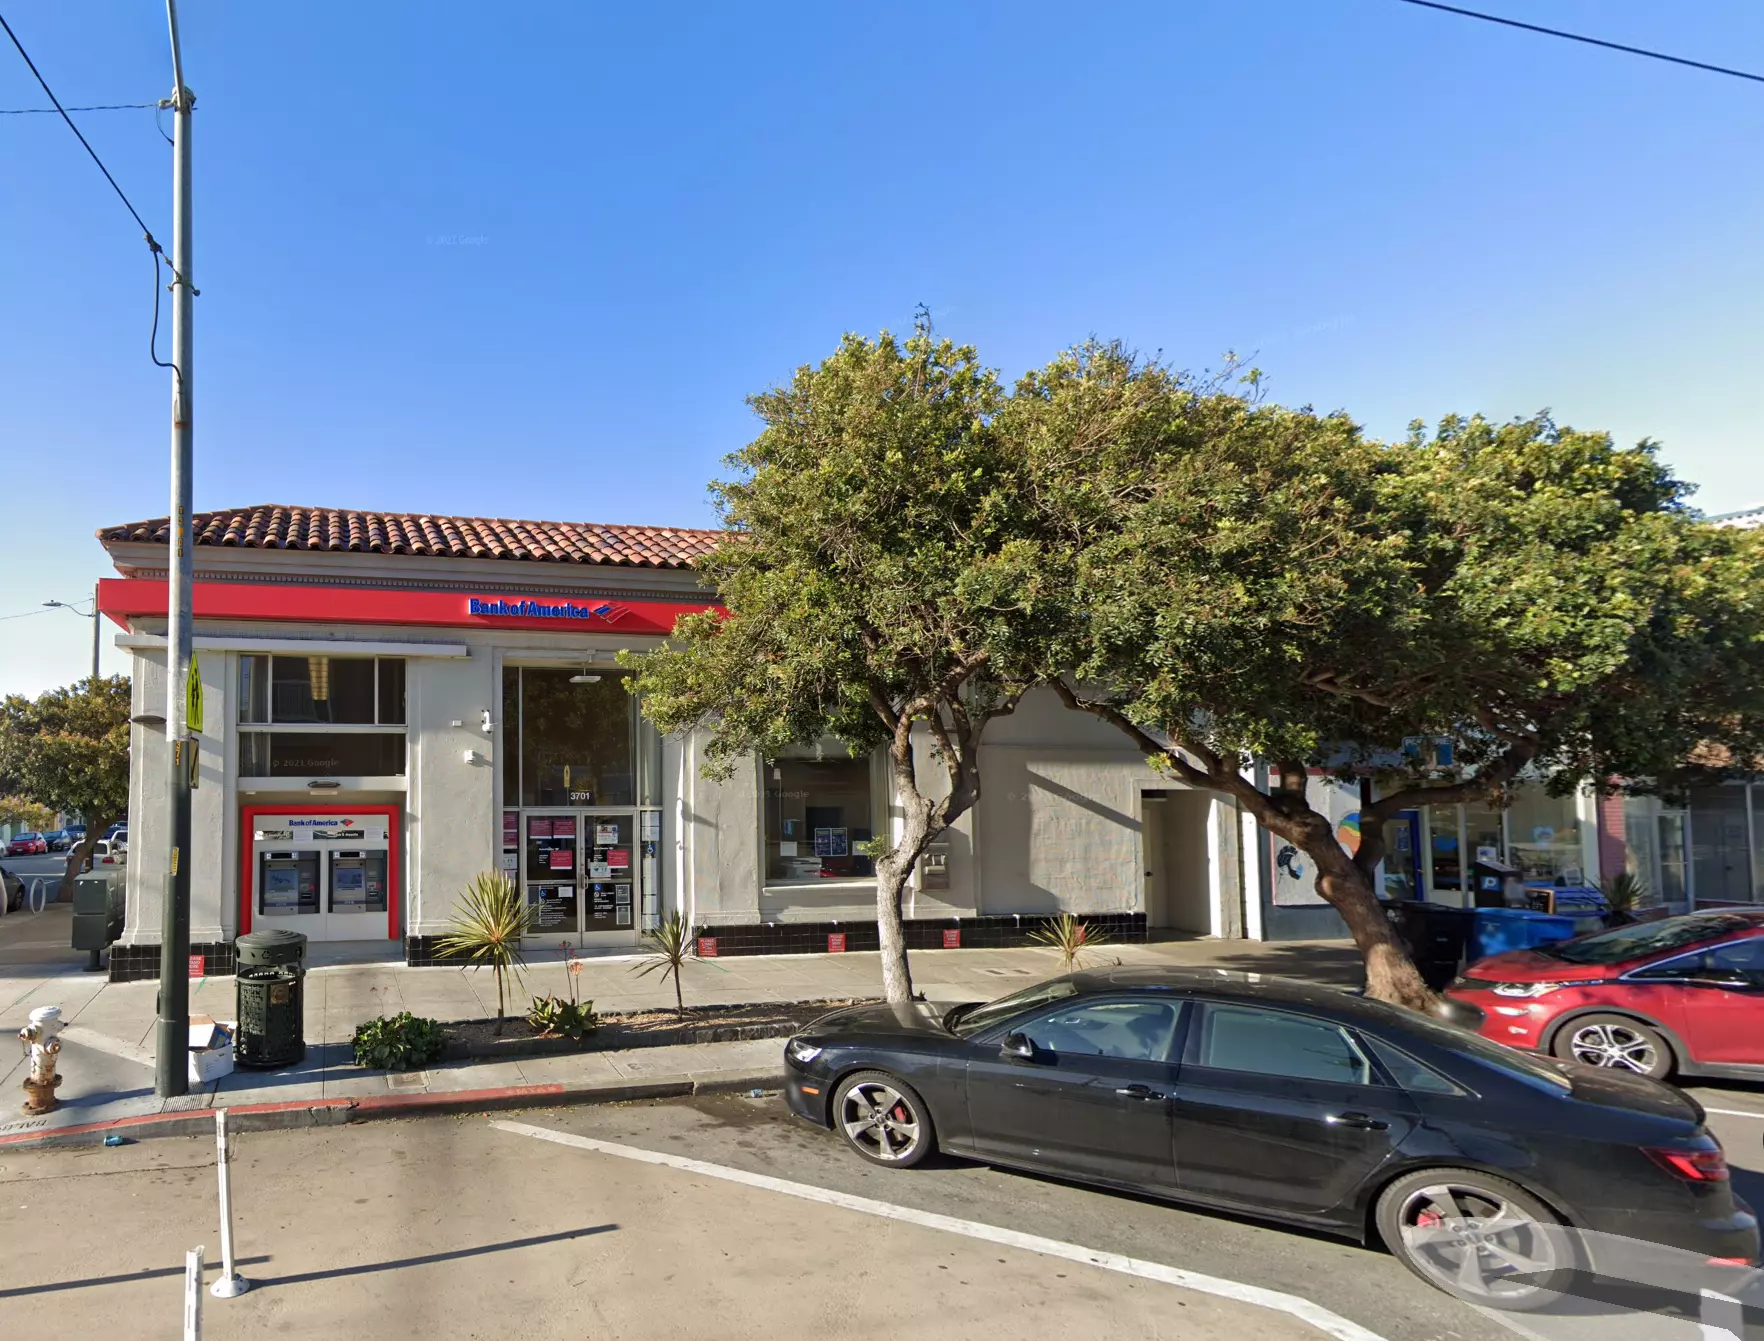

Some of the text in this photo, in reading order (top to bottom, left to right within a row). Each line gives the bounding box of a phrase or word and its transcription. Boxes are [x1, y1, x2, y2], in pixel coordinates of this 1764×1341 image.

[469, 598, 590, 619] Bank of America
[570, 792, 591, 800] 3701
[288, 819, 338, 827] Bank of America
